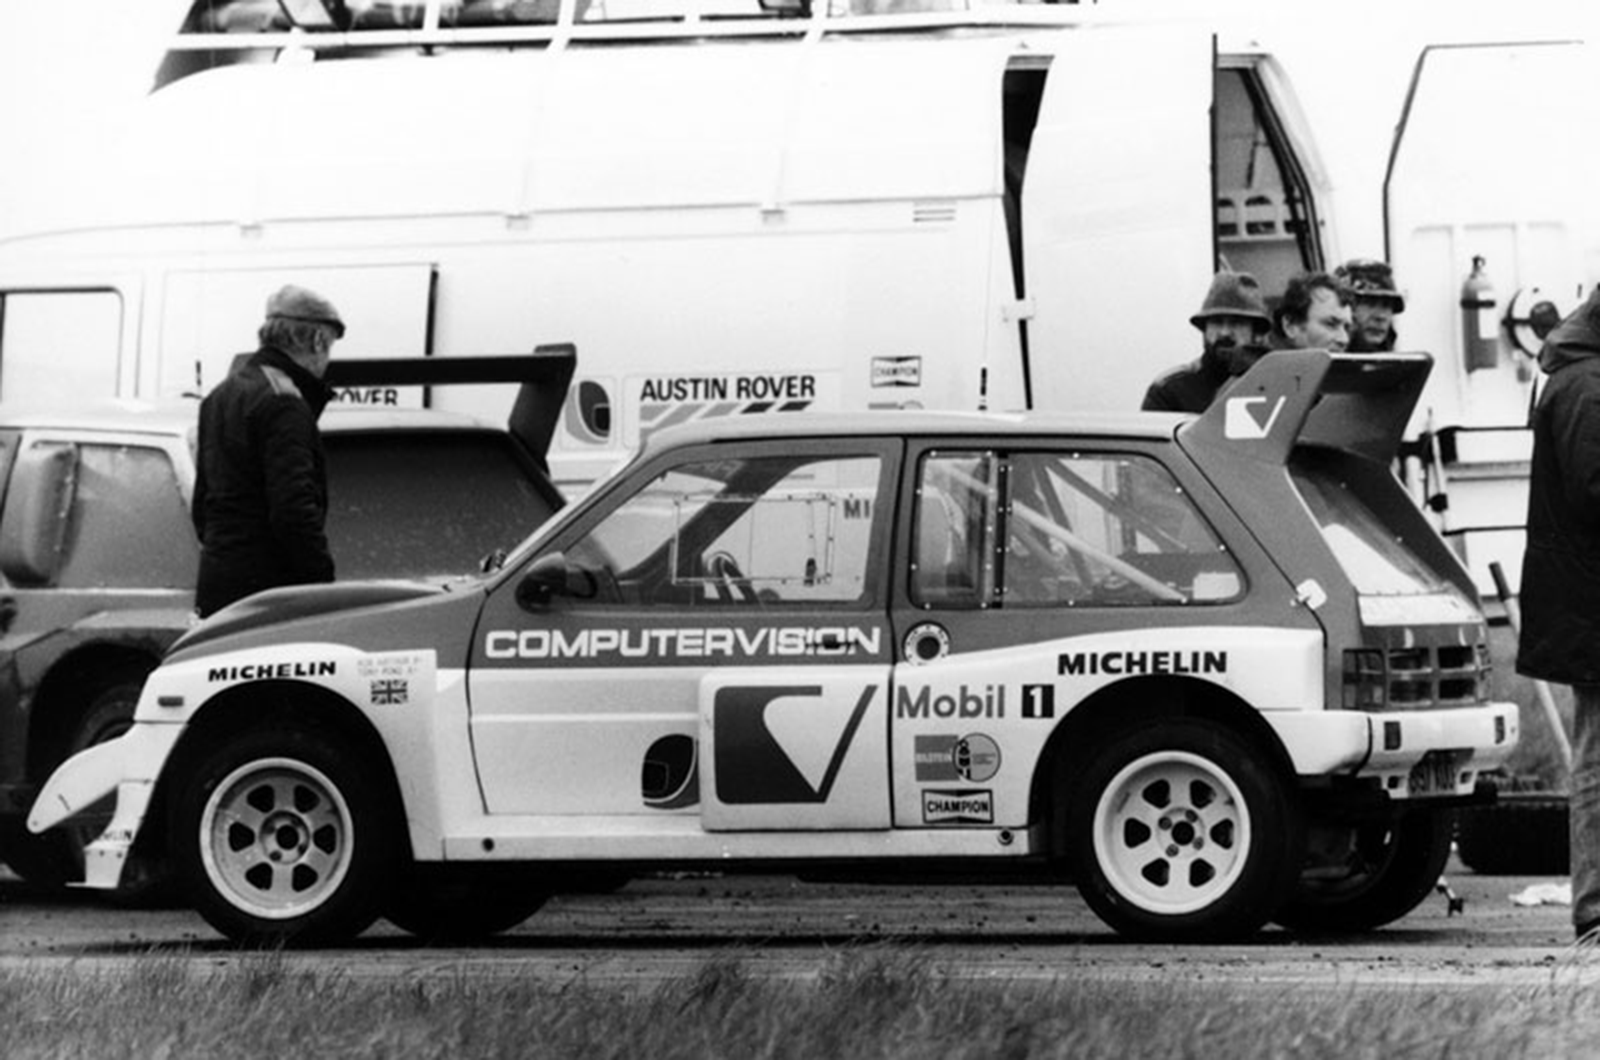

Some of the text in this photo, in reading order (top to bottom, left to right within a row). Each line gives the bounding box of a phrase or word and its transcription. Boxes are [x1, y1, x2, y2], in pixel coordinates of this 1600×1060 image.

[640, 374, 816, 402] AUSTIN ROVER
[485, 626, 881, 659] COMPUTERVISION
[208, 661, 336, 682] MICHELIN
[1057, 651, 1227, 676] MICHELIN
[896, 684, 1046, 719] Mobil 1
[926, 799, 989, 814] CHAMPION
